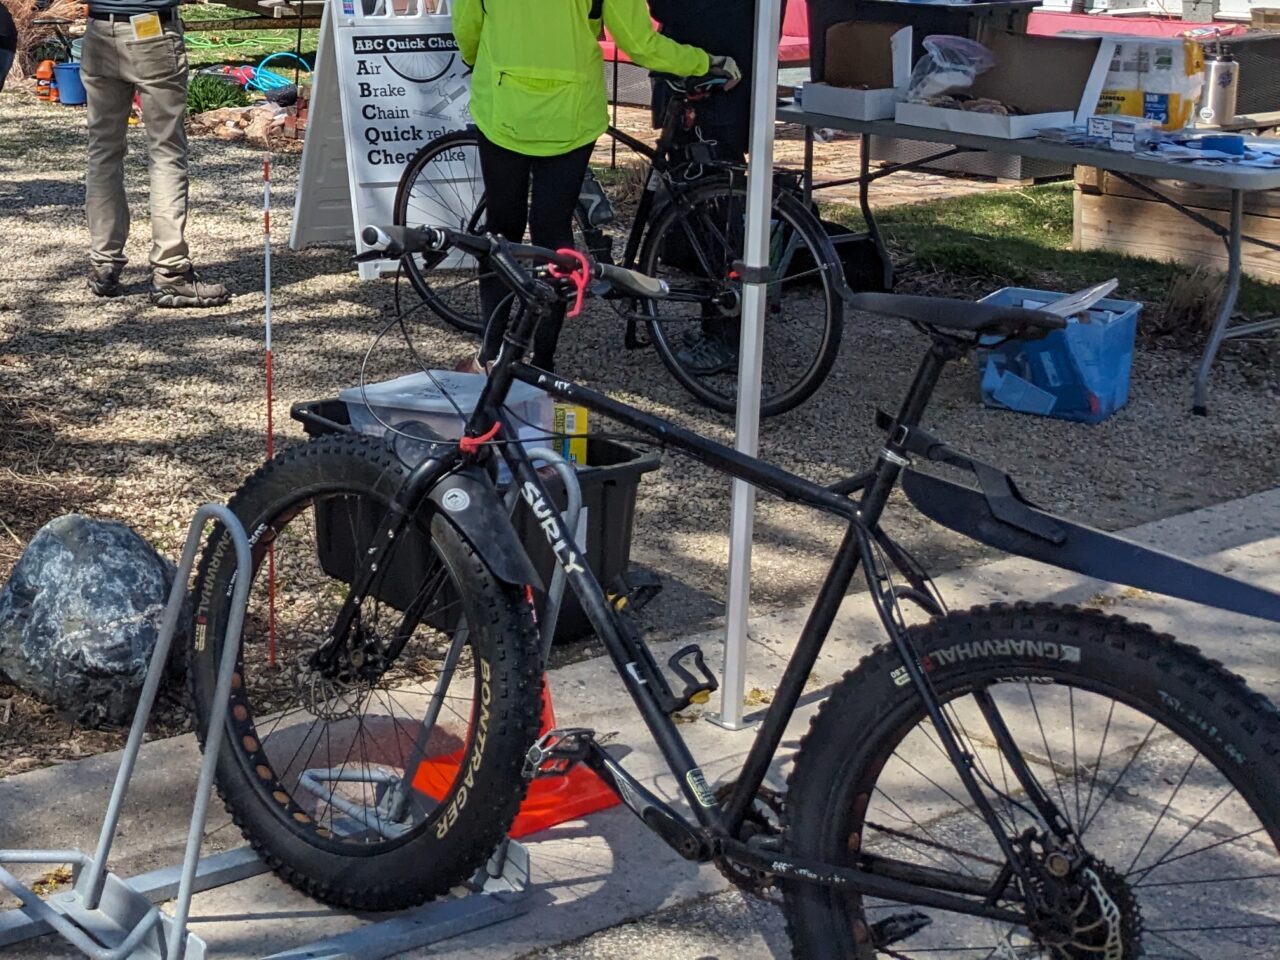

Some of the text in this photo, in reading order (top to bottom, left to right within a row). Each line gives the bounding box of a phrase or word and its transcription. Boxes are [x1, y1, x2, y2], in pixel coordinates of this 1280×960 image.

[355, 37, 461, 52] ABC Quick Chec
[356, 60, 382, 76] Air
[358, 82, 406, 98] Brake
[362, 104, 410, 120] Chain
[364, 125, 456, 146] Quick rele
[367, 148, 420, 165] Chec
[248, 522, 269, 548] SUR
[521, 481, 585, 574] SURLY
[928, 639, 1060, 666] GNARWHAL
[435, 656, 492, 839] BONTRAGER
